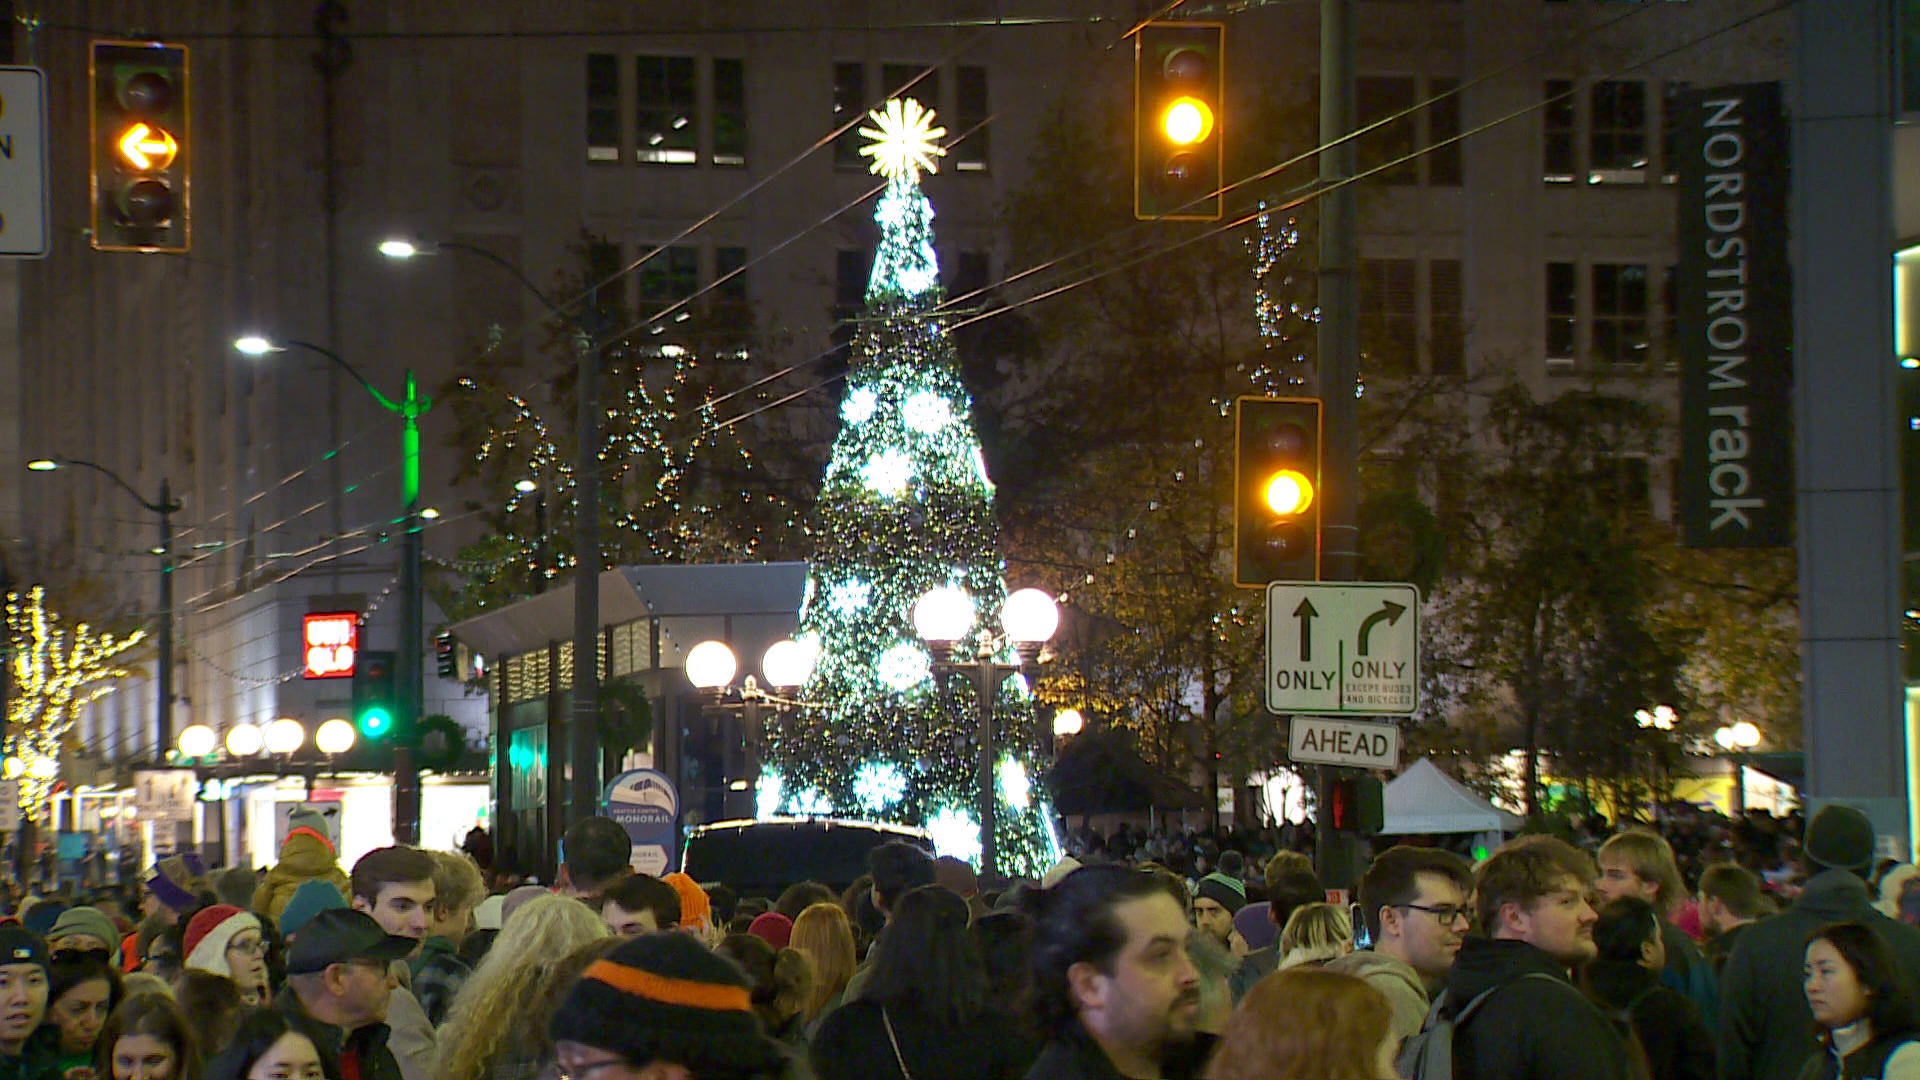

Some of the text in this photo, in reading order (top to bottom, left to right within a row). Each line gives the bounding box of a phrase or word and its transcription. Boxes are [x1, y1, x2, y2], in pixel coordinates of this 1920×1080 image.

[1702, 99, 1765, 532] NORDSTROM rack
[1276, 670, 1336, 690] ONLY
[1351, 660, 1406, 680] ONLY
[1345, 683, 1412, 694] EXCEPT BUSES
[1345, 695, 1411, 705] AND BICYCLES
[1300, 728, 1388, 757] AHEAD
[615, 814, 670, 824] MONORAIL
